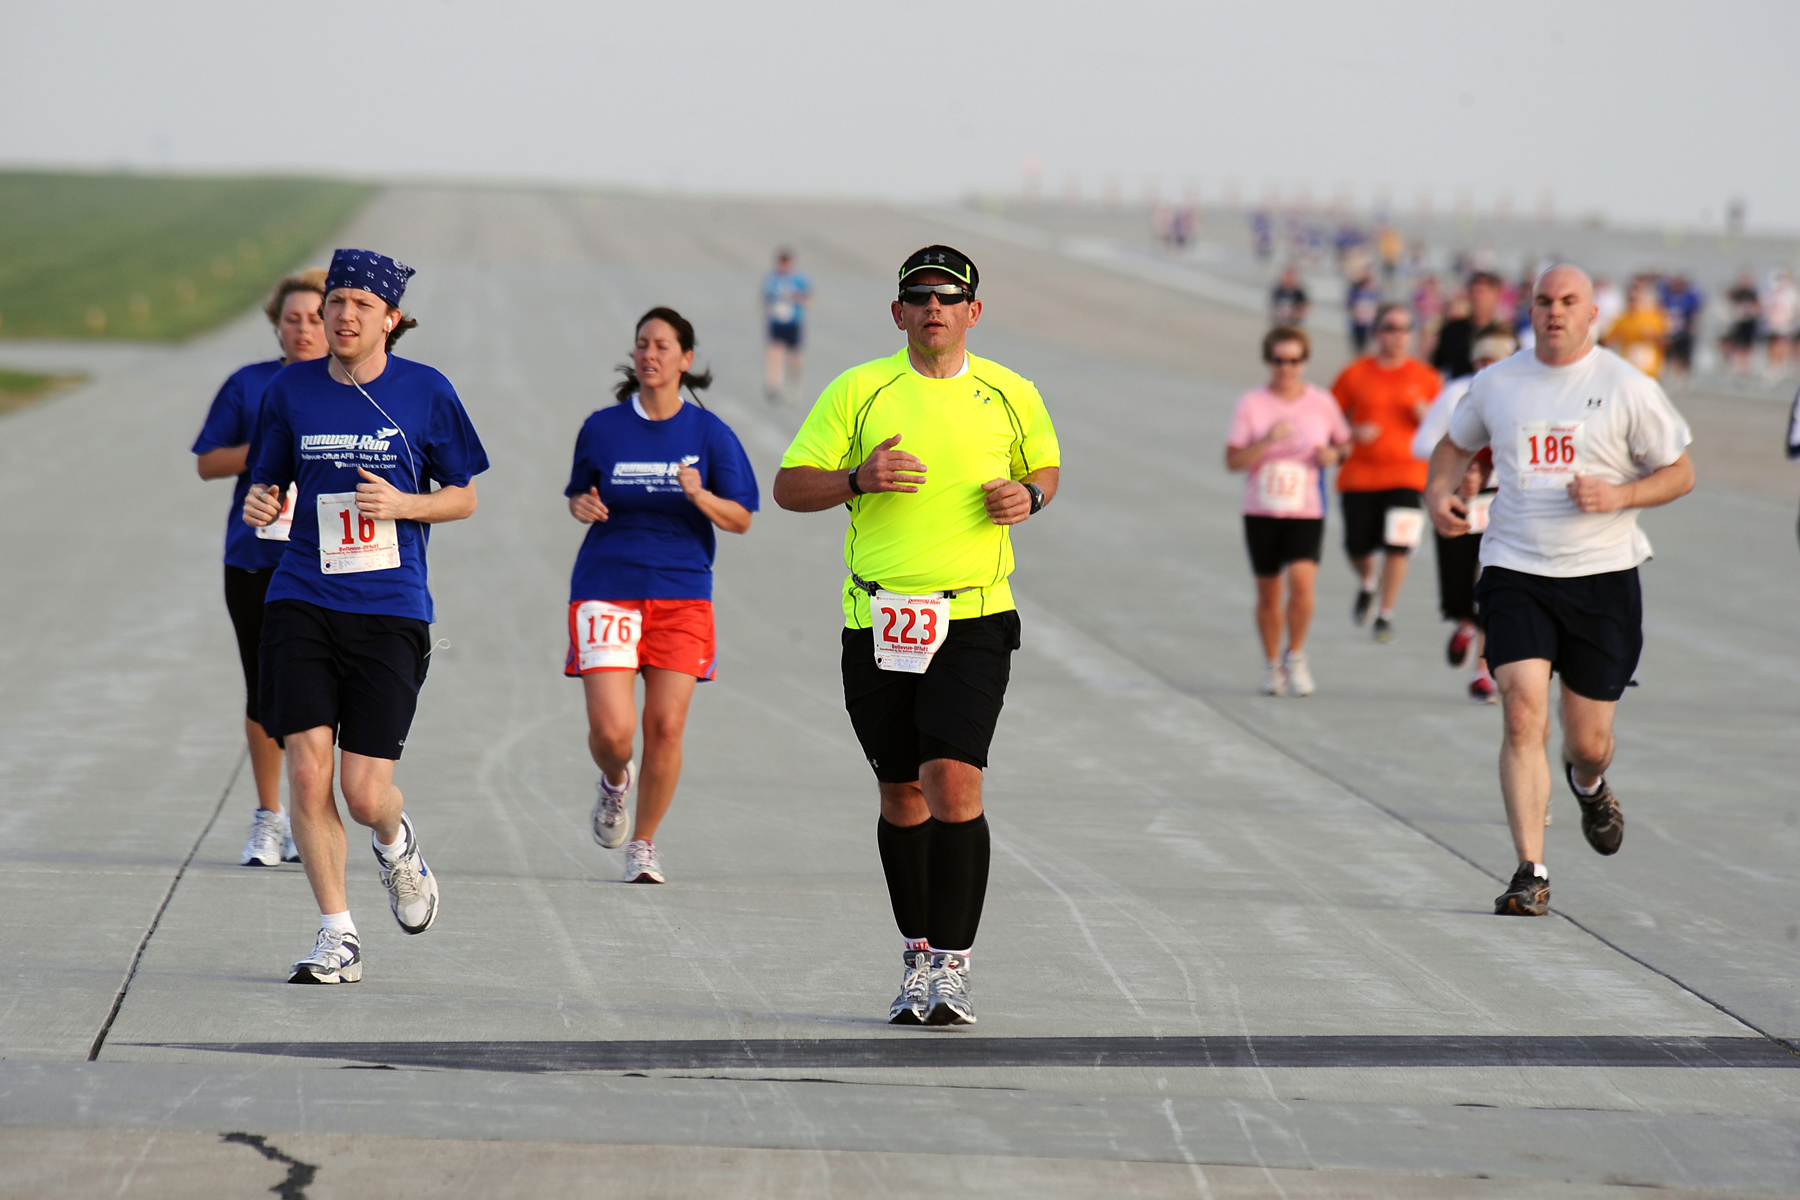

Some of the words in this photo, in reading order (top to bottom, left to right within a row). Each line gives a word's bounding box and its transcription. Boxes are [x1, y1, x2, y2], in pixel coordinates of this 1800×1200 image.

[301, 434, 359, 450] Runway
[358, 434, 390, 451] Run
[340, 452, 355, 460] AFB
[360, 453, 373, 461] May
[382, 453, 398, 461] 2011
[1528, 435, 1575, 465] 186
[339, 509, 375, 545] 16
[587, 614, 631, 644] 176
[880, 607, 937, 645] 223
